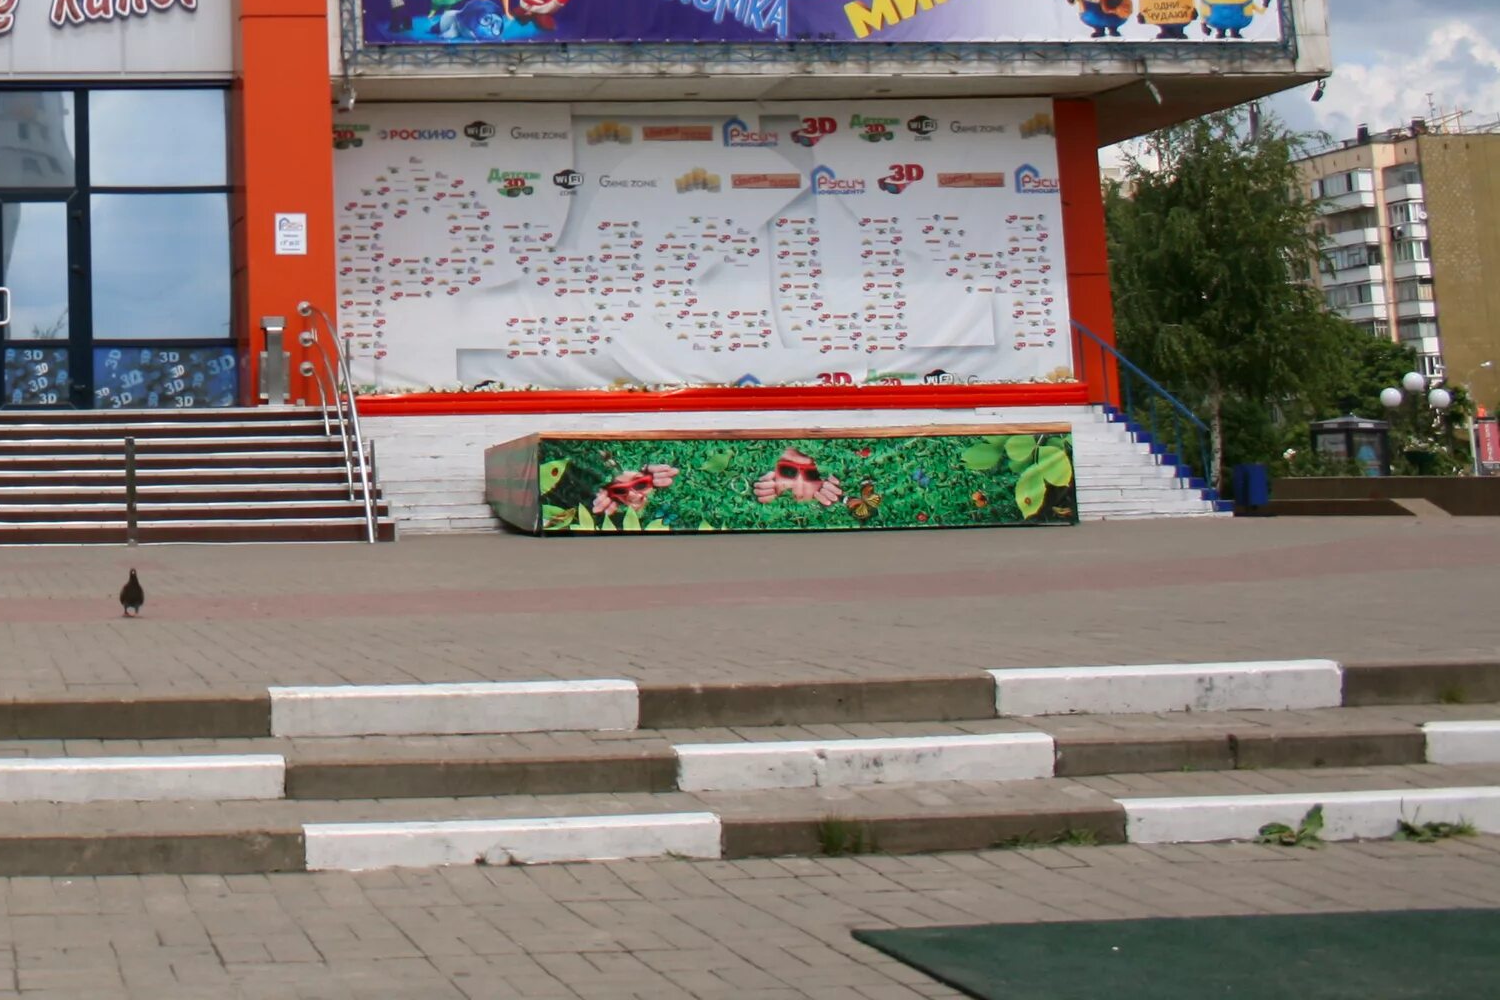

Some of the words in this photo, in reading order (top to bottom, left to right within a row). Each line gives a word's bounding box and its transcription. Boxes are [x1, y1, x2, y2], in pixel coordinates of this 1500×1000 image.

[802, 117, 837, 134] 3D
[389, 129, 457, 140] РОСКИНО
[889, 164, 924, 181] 3D
[1022, 174, 1059, 188] Руси
[24, 350, 43, 361] 3D
[159, 352, 180, 363] 3D
[164, 379, 184, 395] 3D
[38, 394, 57, 404] 3D
[111, 392, 132, 408] 3D
[175, 396, 194, 407] 3D
